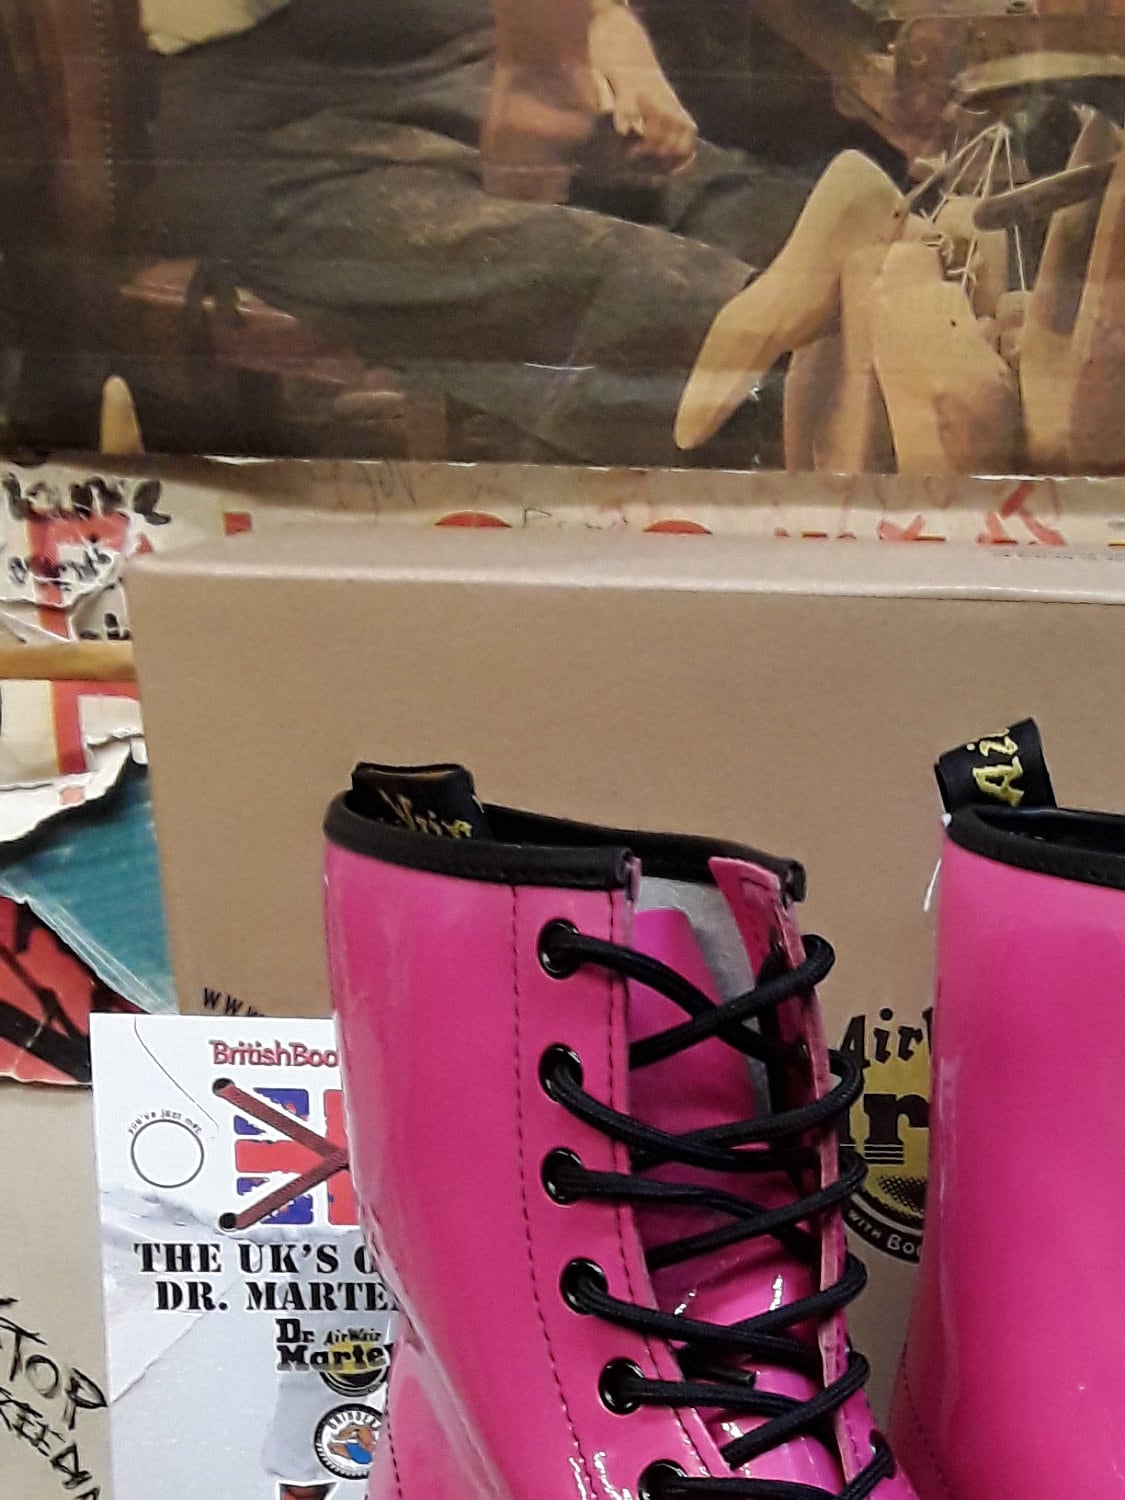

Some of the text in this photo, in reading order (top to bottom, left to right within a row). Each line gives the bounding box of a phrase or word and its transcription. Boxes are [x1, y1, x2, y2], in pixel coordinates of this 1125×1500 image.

[134, 1242, 222, 1273] THE
[237, 1242, 340, 1275] UK'S
[155, 1280, 399, 1311] DR. MARTE
[276, 1342, 394, 1372] Marte
